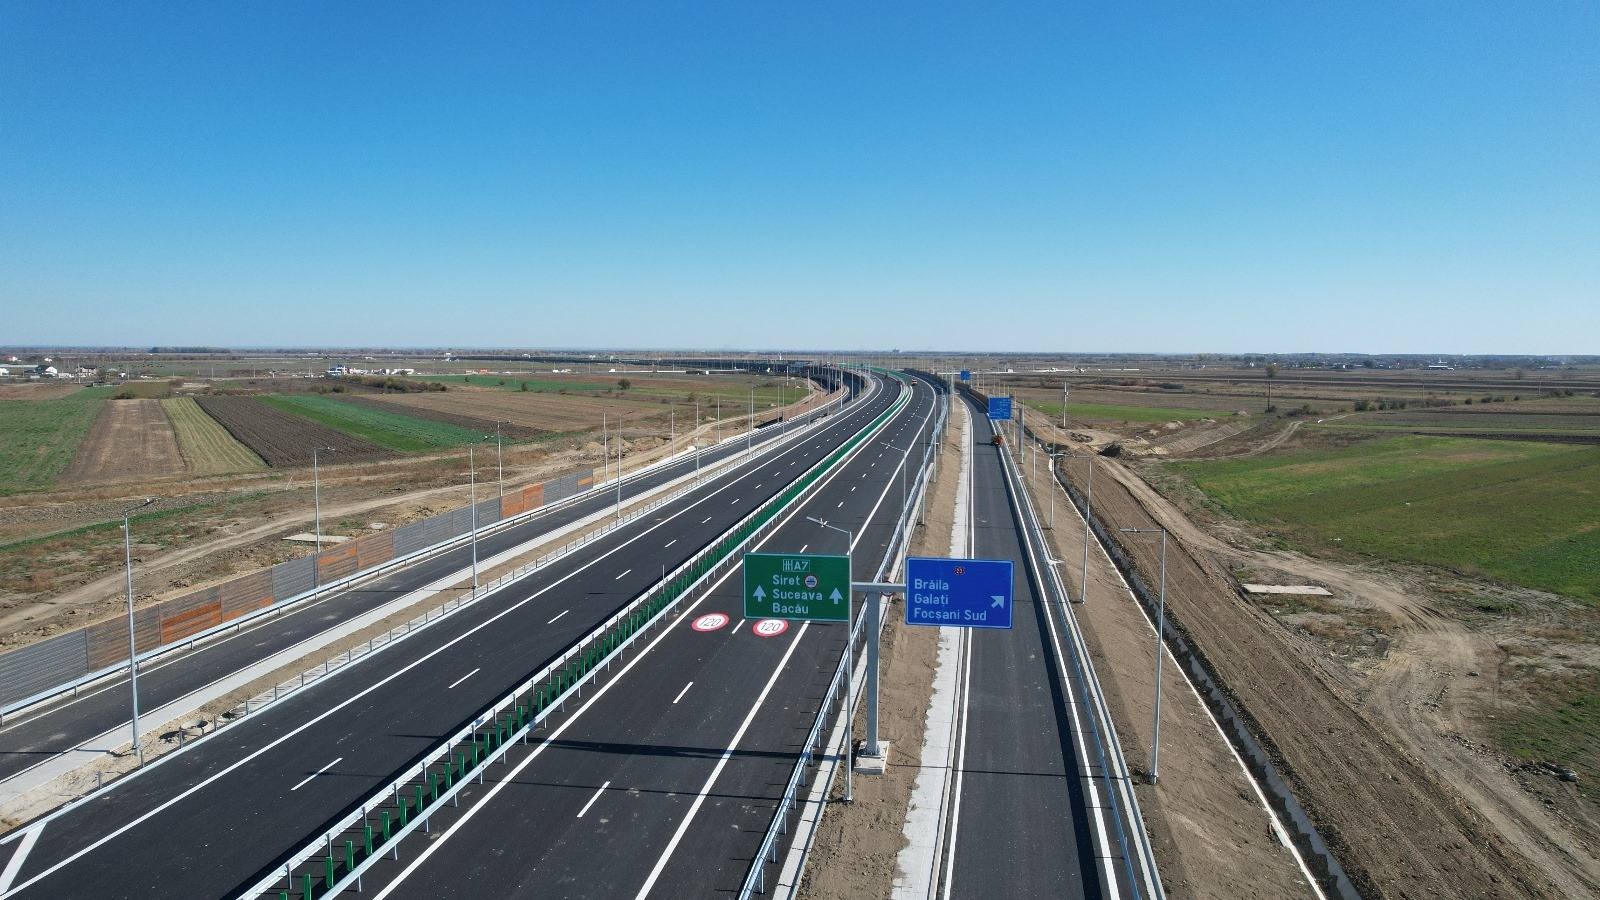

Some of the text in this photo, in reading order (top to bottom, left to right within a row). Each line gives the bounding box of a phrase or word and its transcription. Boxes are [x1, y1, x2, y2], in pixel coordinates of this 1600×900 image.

[794, 561, 809, 571] A7
[772, 574, 800, 586] Siret
[914, 578, 949, 591] Brăila
[772, 589, 823, 601] Suceava
[914, 594, 949, 607] Galați
[772, 603, 809, 614] Bacău
[964, 610, 987, 621] Sud
[700, 617, 722, 627] 120
[760, 622, 780, 631] 120
